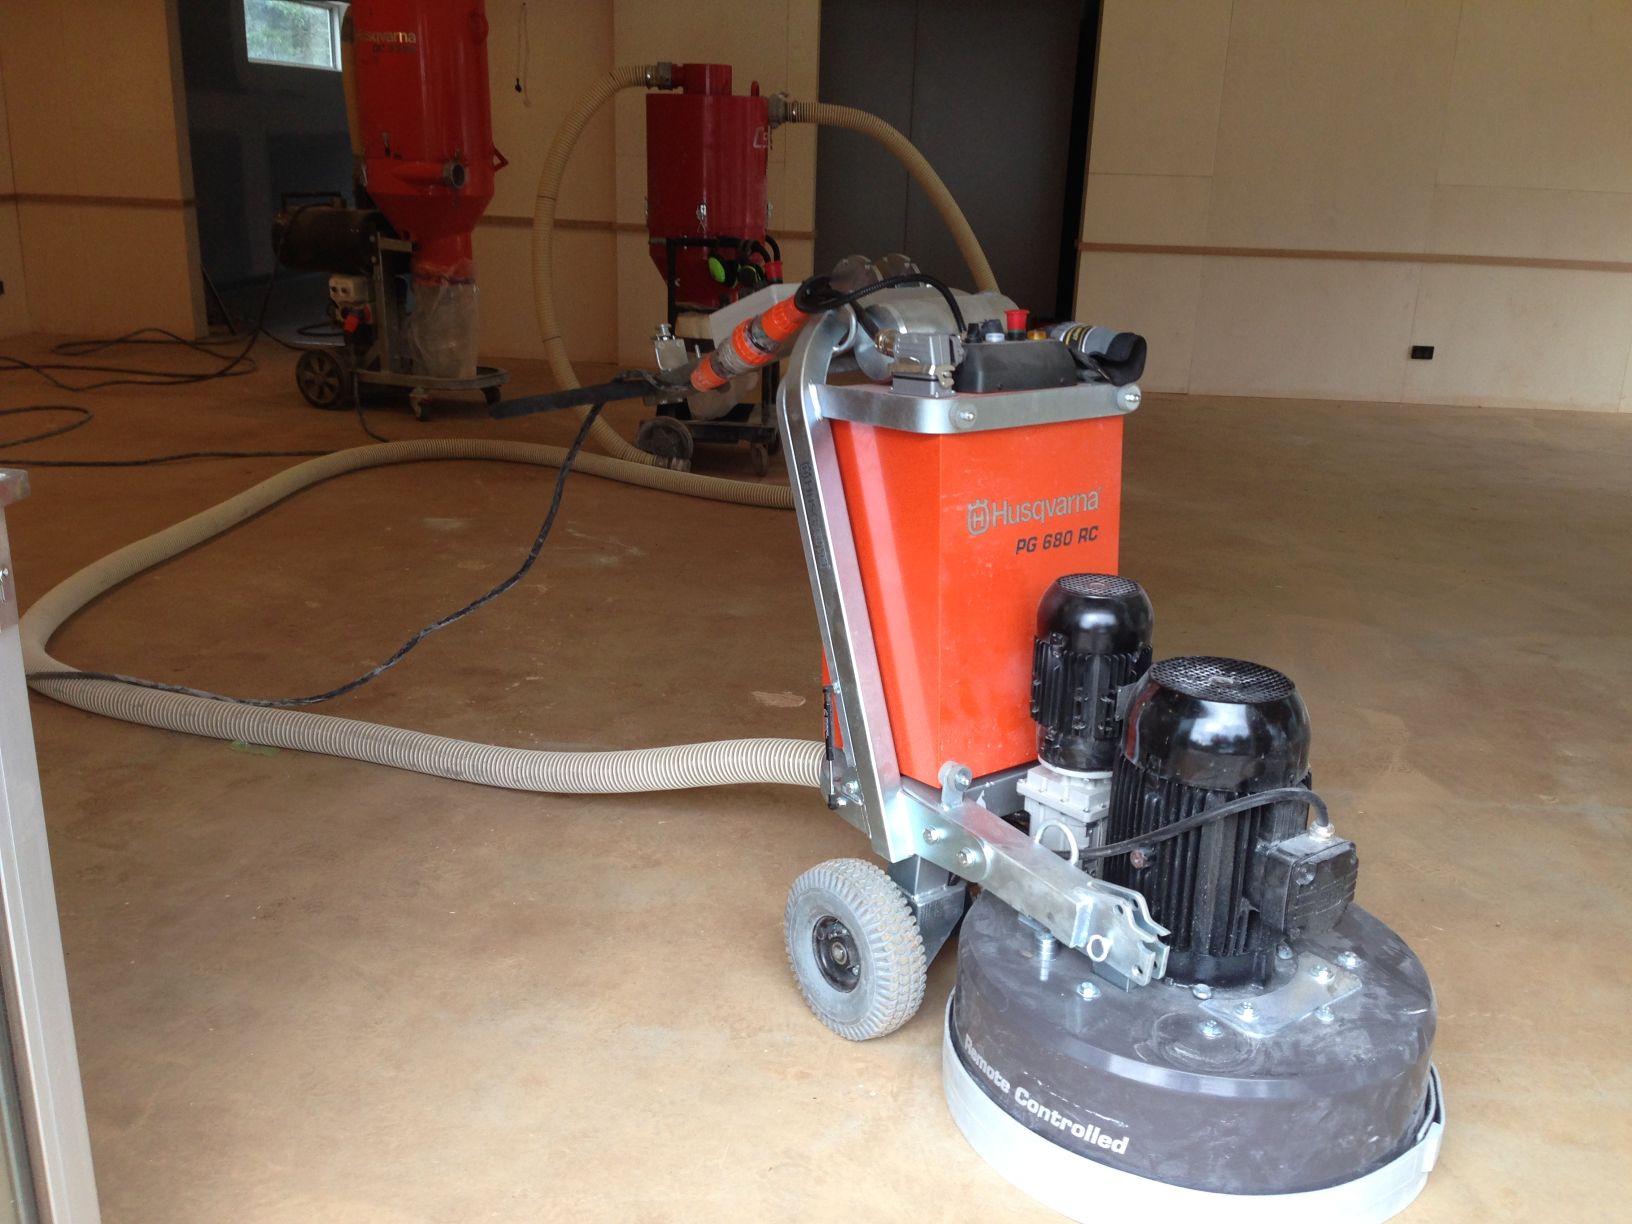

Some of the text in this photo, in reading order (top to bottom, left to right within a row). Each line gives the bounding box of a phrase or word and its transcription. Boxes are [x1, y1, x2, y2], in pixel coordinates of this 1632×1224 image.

[992, 490, 1099, 528] Husqvarna
[1016, 525, 1099, 555] PG 680 RC
[964, 1033, 1130, 1155] Remote Controlled
